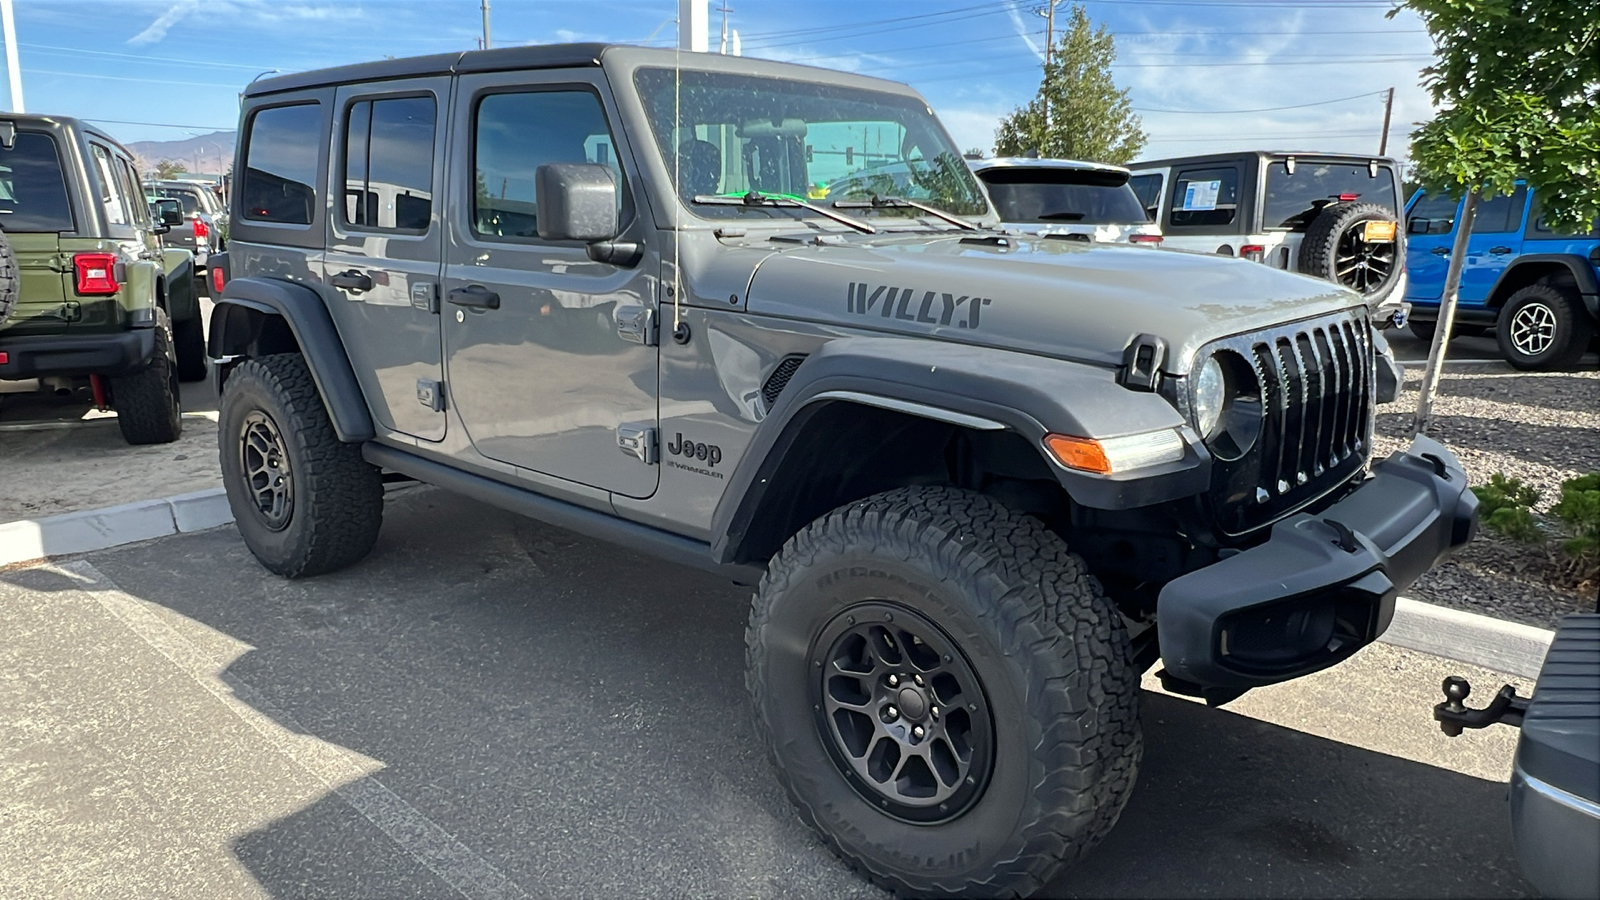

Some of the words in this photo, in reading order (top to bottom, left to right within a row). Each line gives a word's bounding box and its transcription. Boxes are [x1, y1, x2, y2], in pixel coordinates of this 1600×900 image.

[847, 282, 992, 329] WILLYS
[668, 432, 722, 468] Jeep
[675, 462, 724, 480] WRANGLER
